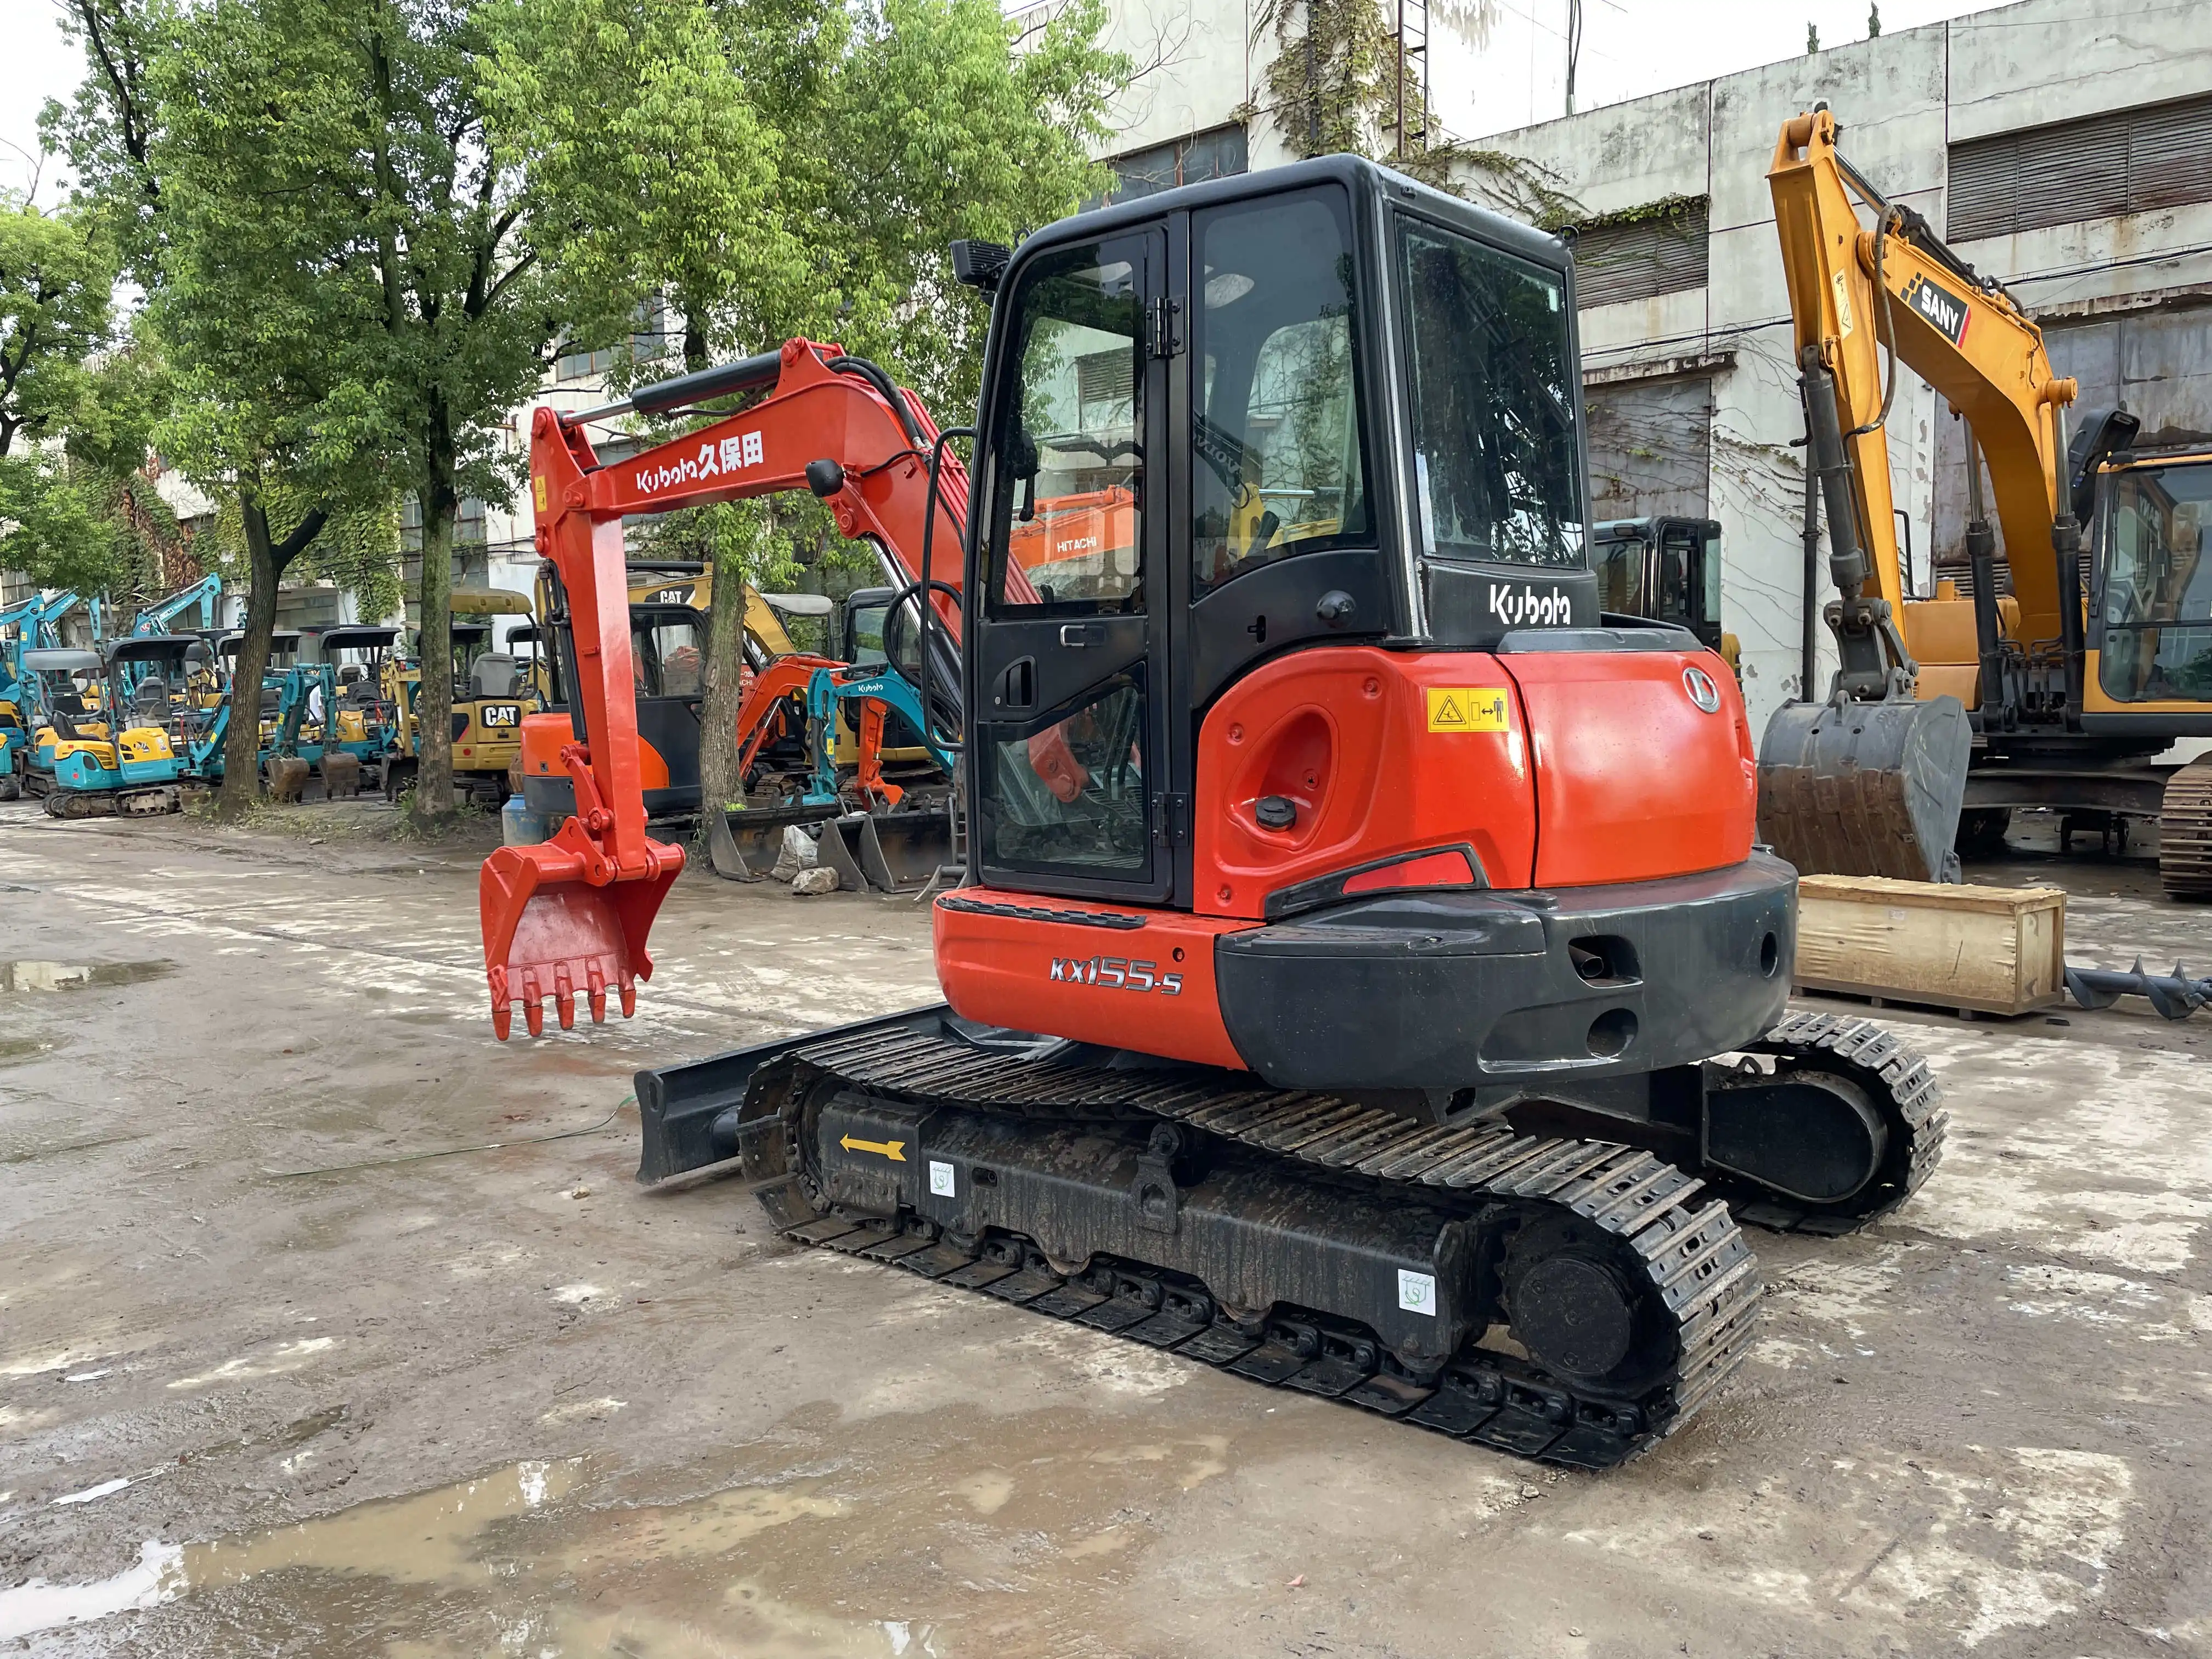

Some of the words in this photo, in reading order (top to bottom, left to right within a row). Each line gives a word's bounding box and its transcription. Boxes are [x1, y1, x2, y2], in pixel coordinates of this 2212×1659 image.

[1921, 284, 1959, 335] SANY
[636, 458, 698, 494] Kubota
[698, 430, 764, 481] 久保田
[1057, 536, 1097, 553] HITACHI
[660, 590, 682, 603] CAT
[1489, 584, 1571, 625] Kubota
[858, 682, 883, 693] Kubota
[485, 707, 516, 726] CAT
[1049, 955, 1184, 996] KX155-5
